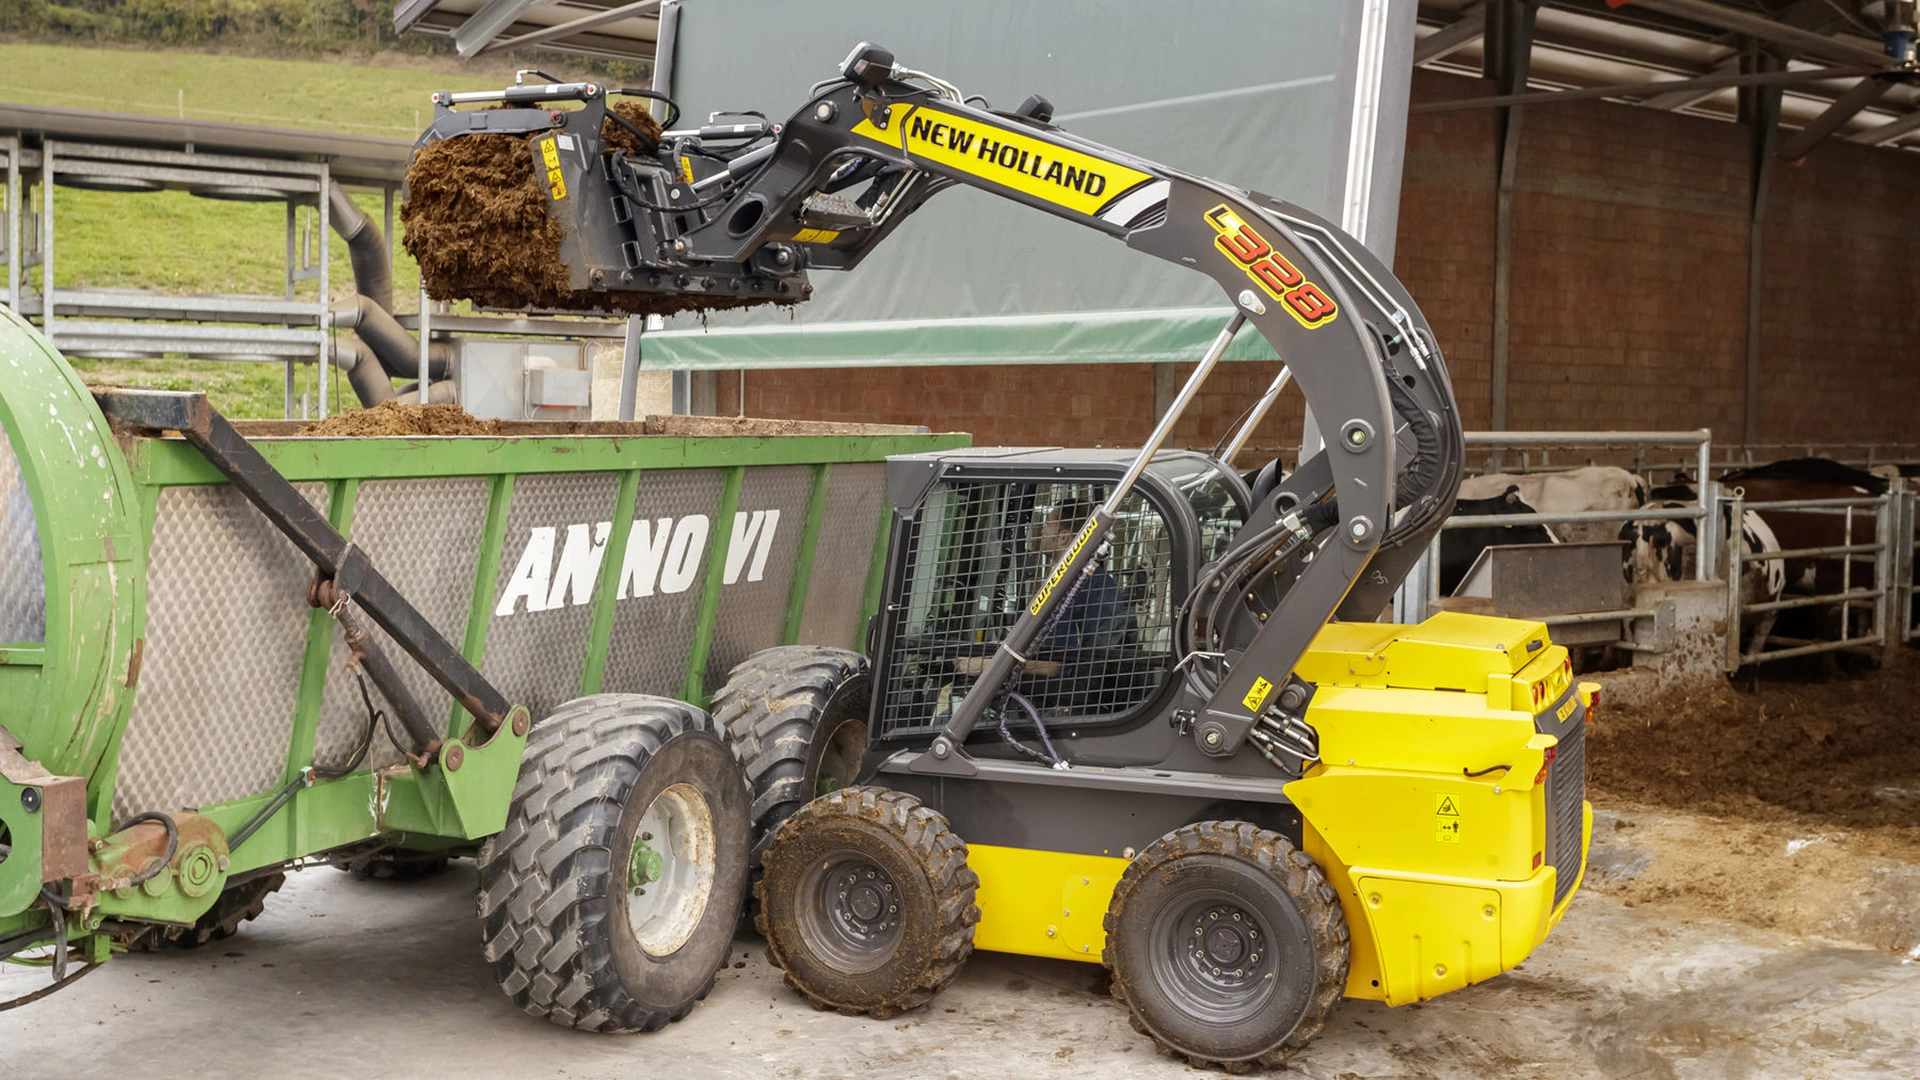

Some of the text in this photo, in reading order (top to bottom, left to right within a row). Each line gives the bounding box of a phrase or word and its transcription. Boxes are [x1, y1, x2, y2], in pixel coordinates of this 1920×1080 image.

[911, 115, 1107, 197] NEW HOLLAND
[1206, 205, 1338, 325] L328
[1031, 518, 1097, 614] SUPER BOOM
